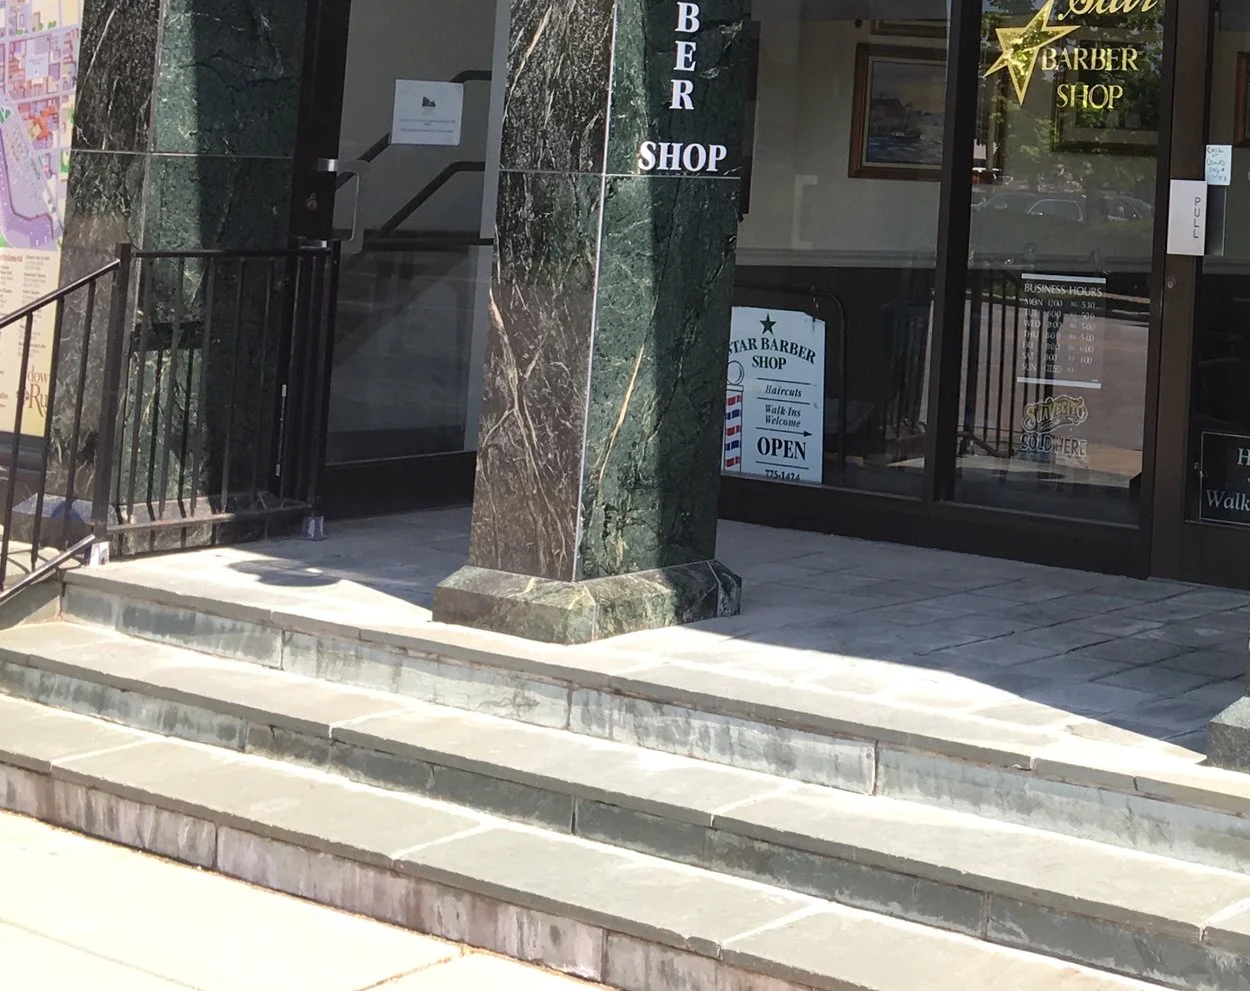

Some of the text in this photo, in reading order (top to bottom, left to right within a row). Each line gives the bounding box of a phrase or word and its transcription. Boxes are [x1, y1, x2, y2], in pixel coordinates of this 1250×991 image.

[1041, 47, 1140, 72] BARBER
[1056, 83, 1124, 110] SHOP
[636, 141, 728, 173] SHOP
[1193, 196, 1202, 239] PULL
[1024, 282, 1103, 297] BUSINESS HOURS
[1025, 298, 1043, 306] MON
[1023, 330, 1039, 338] THU
[761, 337, 817, 365] BARBER
[752, 355, 787, 370] SHOP
[765, 384, 802, 398] Haircuts
[764, 404, 801, 418] Walk-Ins
[765, 415, 801, 428] Welcome
[757, 437, 807, 461] OPEN
[1021, 433, 1088, 457] SOLD HERE
